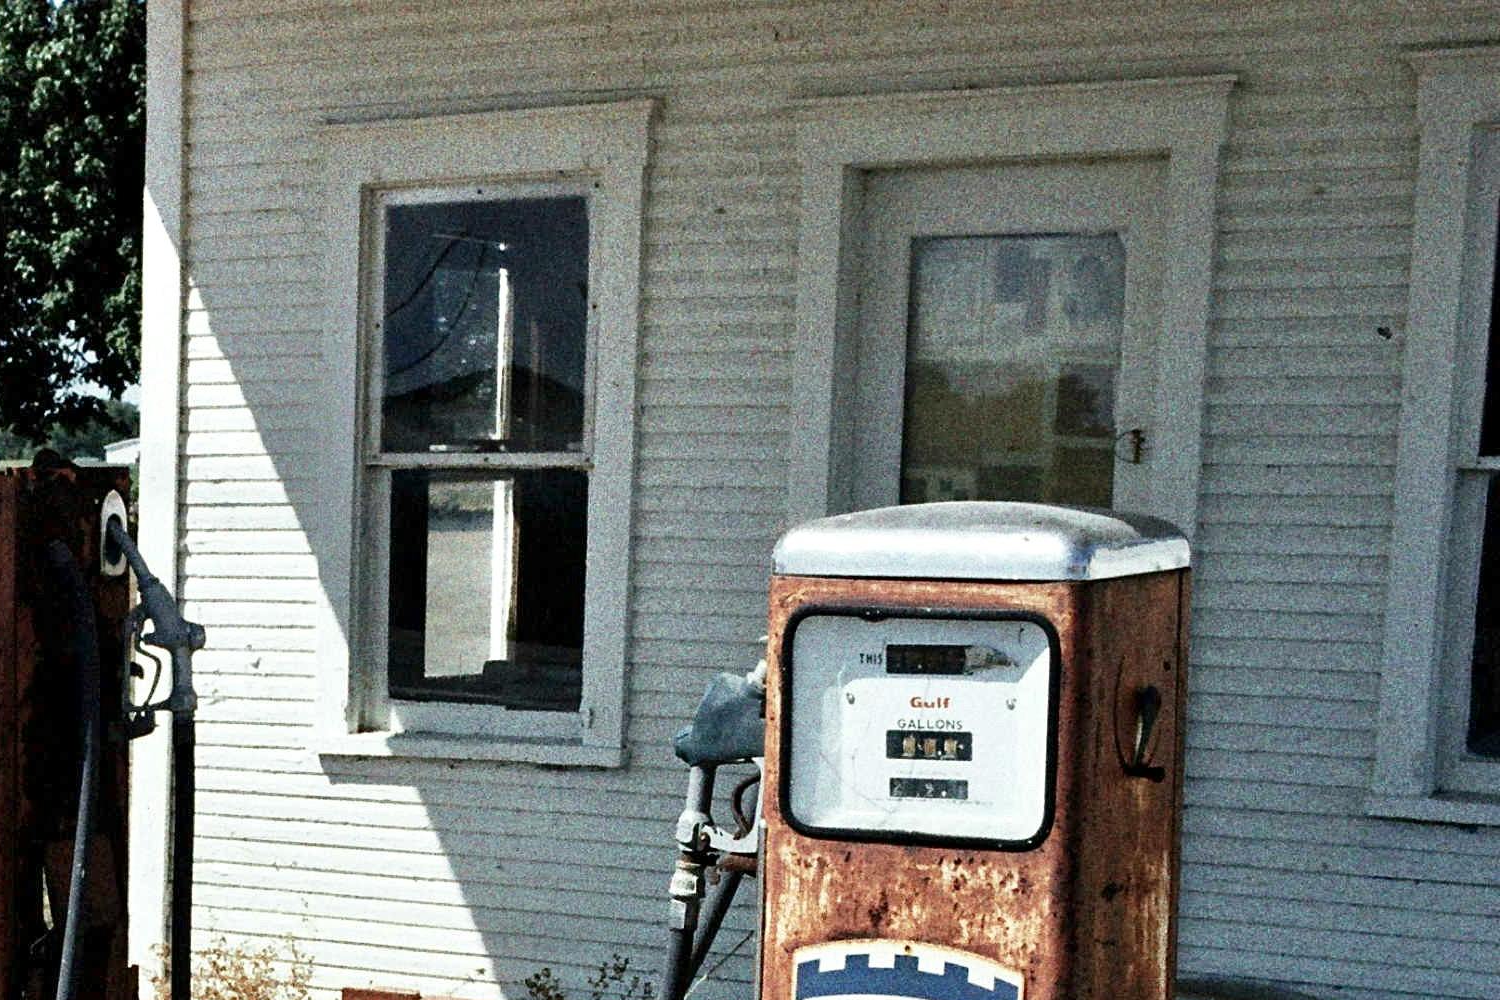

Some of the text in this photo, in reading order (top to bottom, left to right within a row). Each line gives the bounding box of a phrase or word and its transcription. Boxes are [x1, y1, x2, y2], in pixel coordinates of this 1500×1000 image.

[859, 652, 883, 665] THIS
[910, 696, 950, 709] Gulf
[897, 718, 963, 730] GALLONS
